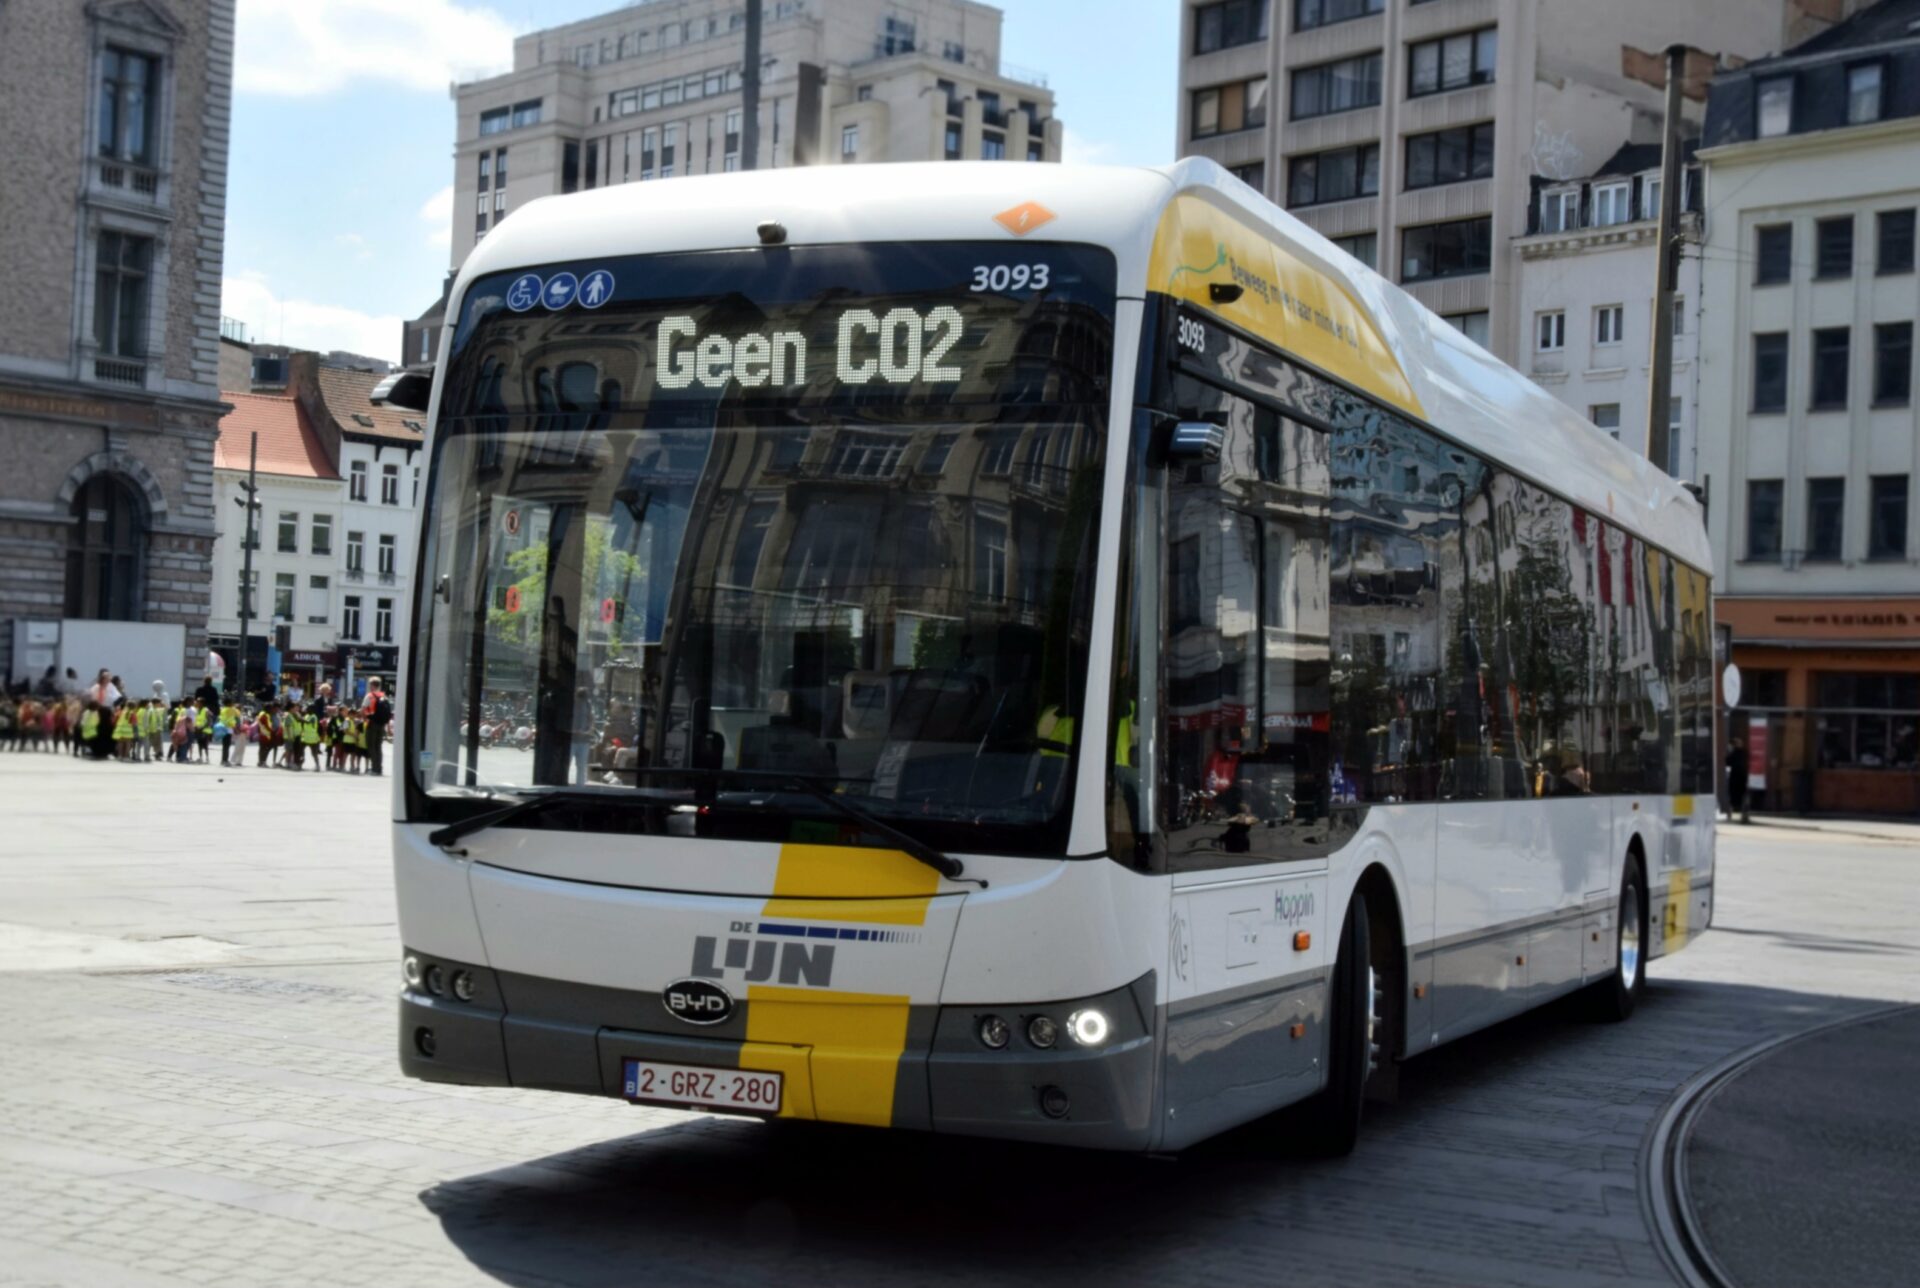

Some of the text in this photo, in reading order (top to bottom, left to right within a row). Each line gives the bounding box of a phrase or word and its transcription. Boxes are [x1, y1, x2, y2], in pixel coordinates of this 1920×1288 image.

[969, 264, 1050, 292] 3093
[656, 306, 963, 389] Geen CO2
[1177, 315, 1205, 352] 3093
[1274, 883, 1314, 927] Hoppin
[730, 921, 753, 934] DE
[691, 935, 836, 987] LIJN
[669, 992, 725, 1012] BYD
[625, 1080, 635, 1093] B
